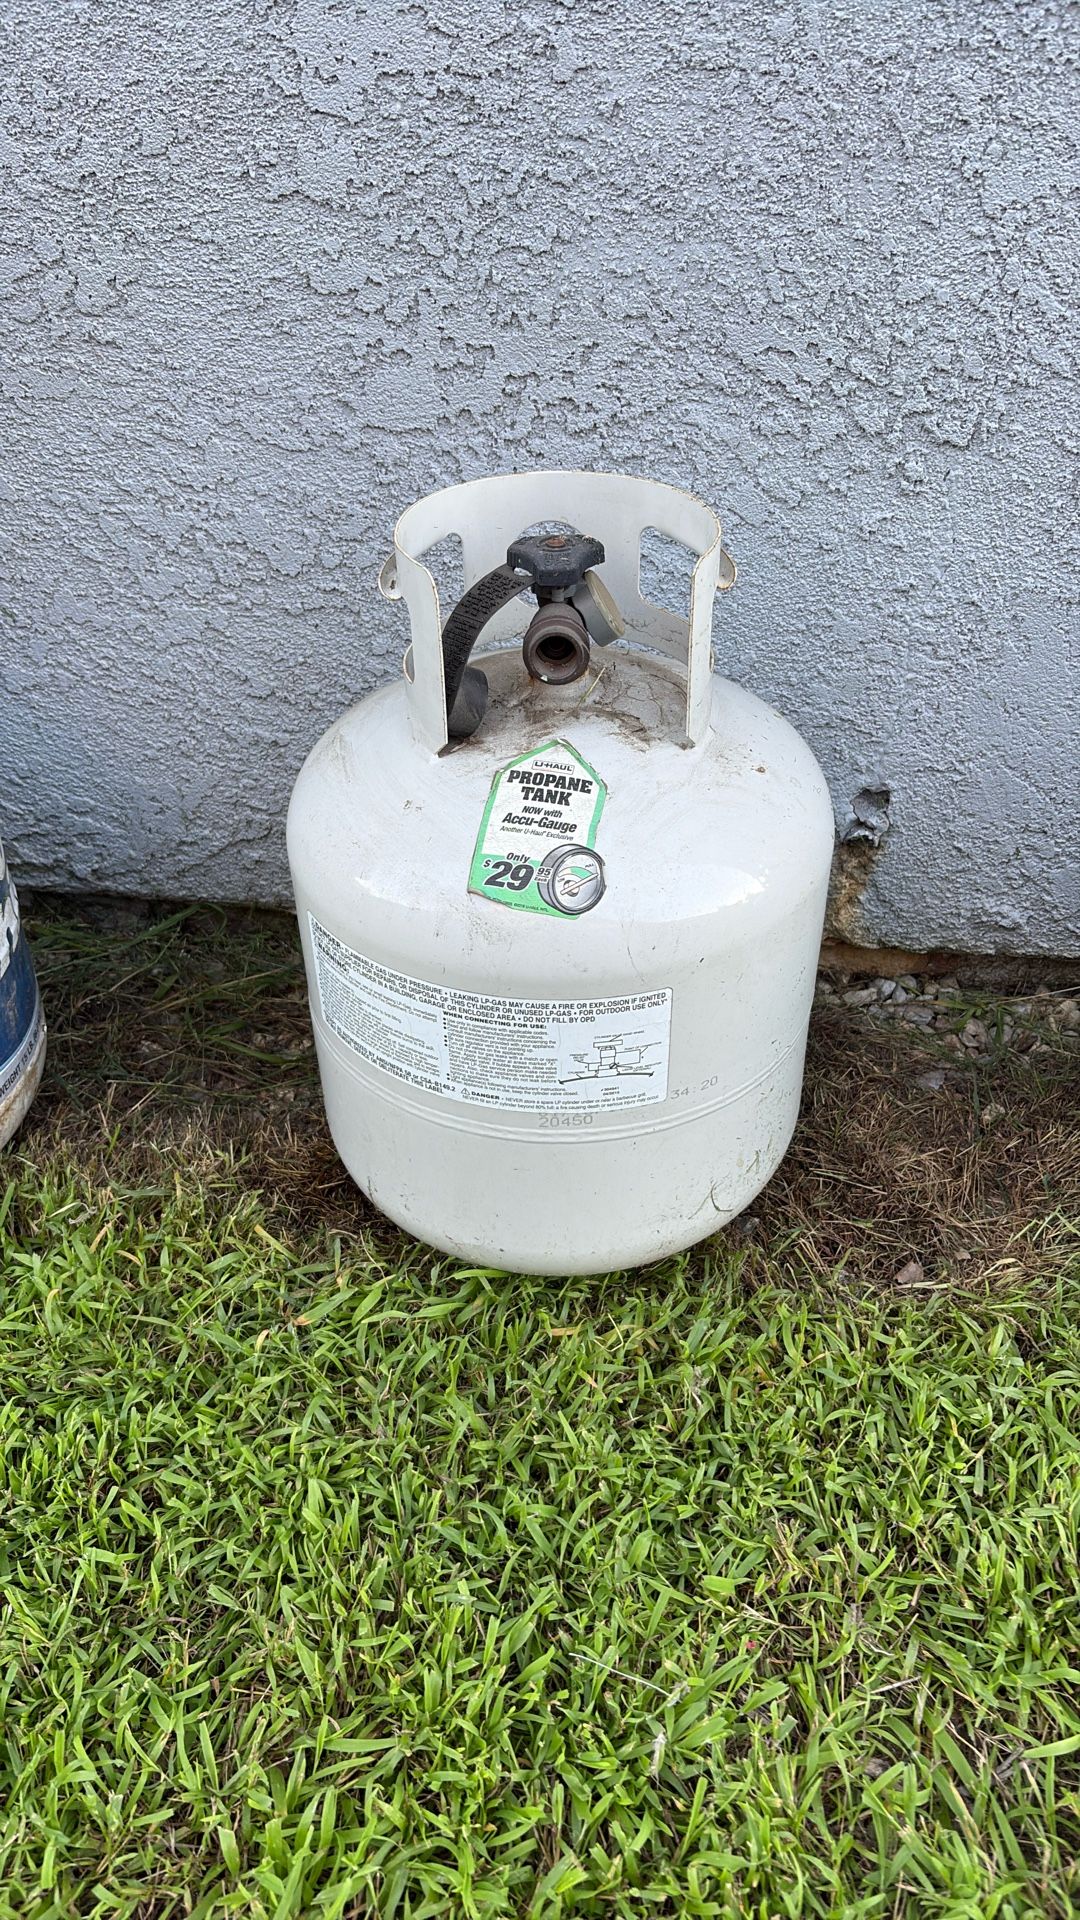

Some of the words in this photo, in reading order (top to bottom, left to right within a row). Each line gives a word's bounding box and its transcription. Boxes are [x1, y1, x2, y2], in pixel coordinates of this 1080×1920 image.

[534, 761, 573, 772] U-HAUL
[507, 770, 594, 794] PROPANE
[521, 786, 572, 806] TANK
[522, 806, 544, 815] NOW
[544, 810, 562, 818] with
[502, 812, 578, 834] Accu-Gauge
[546, 832, 574, 841] Exclusive
[506, 852, 530, 864] Only
[315, 920, 341, 948] DANGER
[344, 948, 374, 970] FLAMMABLE
[375, 966, 388, 976] GAS
[388, 971, 408, 984] UNDER
[409, 980, 442, 995] PRESSURE
[450, 992, 479, 1002] LEAKING
[480, 998, 508, 1007] LP-GAS
[589, 998, 630, 1008] EXPLOSION
[638, 992, 667, 1002] IGNITED
[352, 965, 376, 983] CYLINDER
[389, 984, 418, 1002] BUILDING,
[418, 996, 446, 1009] GARAGE
[446, 1004, 457, 1012] OR
[458, 1007, 496, 1019] ENCLOSED
[362, 964, 372, 975] FOR
[372, 970, 398, 988] REPAIRS,
[398, 982, 407, 991] OR
[408, 986, 438, 1002] DISPOSAL
[440, 995, 448, 1003] OF
[450, 998, 466, 1008] THIS
[466, 1001, 500, 1012] CYLINDER
[595, 1005, 631, 1015] OUTDOOR
[632, 1002, 646, 1010] USE
[442, 1010, 463, 1019] WHEN
[464, 1014, 512, 1027] CONNECTING
[411, 1078, 424, 1087] THIS
[424, 1083, 444, 1095] LABEL
[471, 1090, 500, 1100] DANGER
[538, 1115, 594, 1128] 20450
